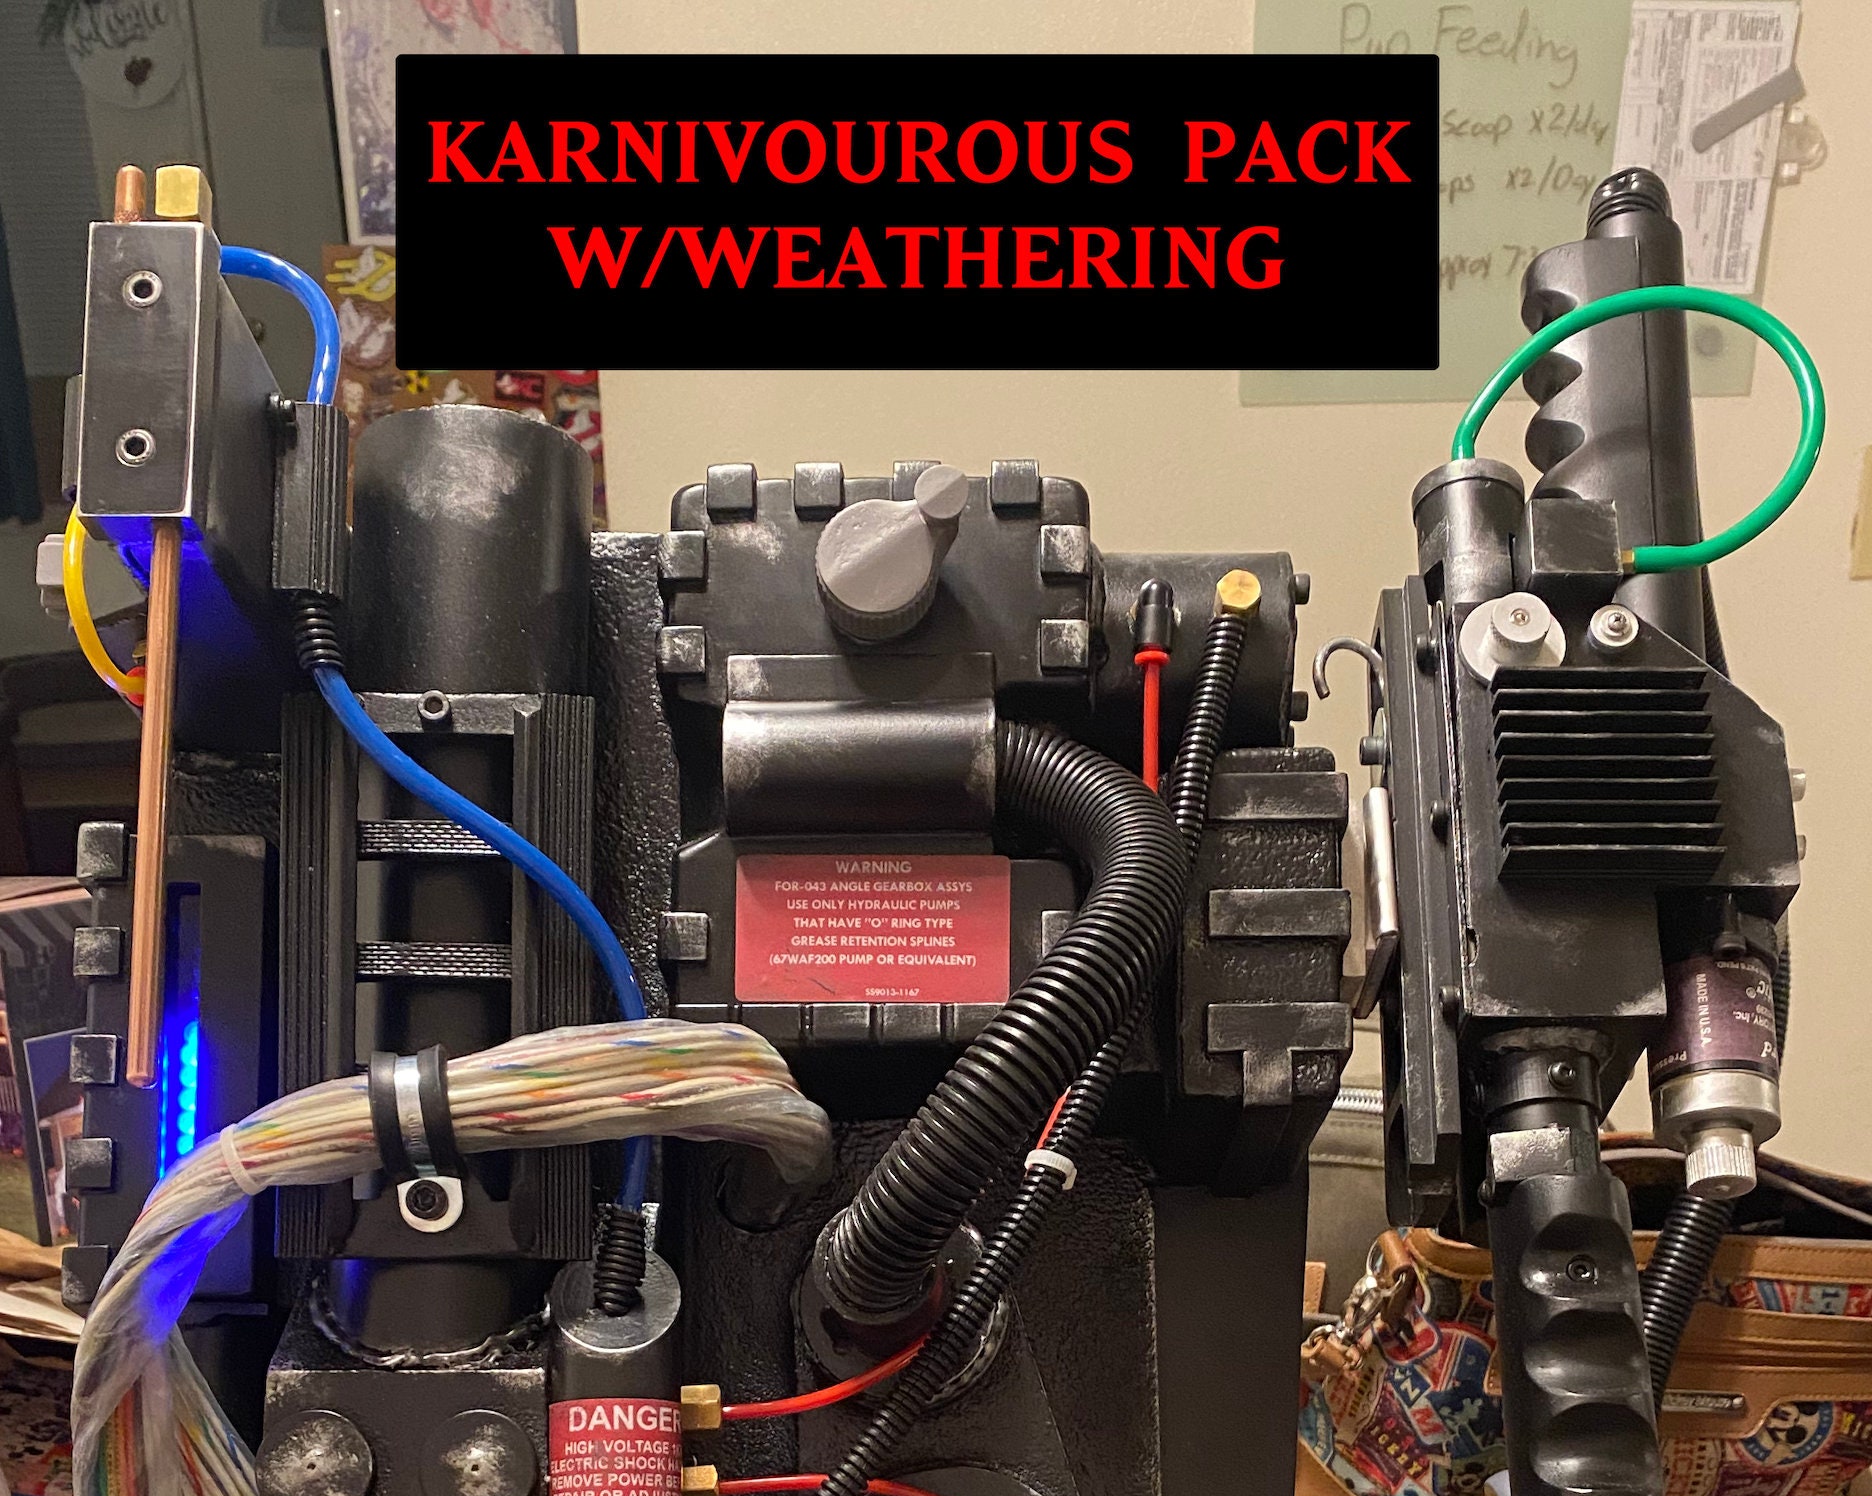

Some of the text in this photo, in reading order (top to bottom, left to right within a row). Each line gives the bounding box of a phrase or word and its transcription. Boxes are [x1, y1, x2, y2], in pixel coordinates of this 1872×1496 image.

[836, 860, 912, 874] WARNING
[830, 881, 871, 892] ANGLE
[873, 882, 933, 893] GEARBOX
[935, 882, 973, 893] ASSYS
[786, 899, 961, 911] USE ONLY HYDRAULIC PUMPS
[793, 917, 953, 929] THAT HAVE "O" RING TYPE
[791, 935, 956, 947] GREASE RETENTION SPLINES
[769, 953, 977, 967] (67WAF200 PUMP OR EQUIVALENT)
[568, 1404, 682, 1433] DANGER
[603, 1439, 670, 1455] VOLTAGE
[550, 1456, 609, 1474] ELECTRIC
[614, 1456, 667, 1472] SHOCK
[551, 1473, 604, 1491] REMOVE
[607, 1472, 663, 1488] POWER
